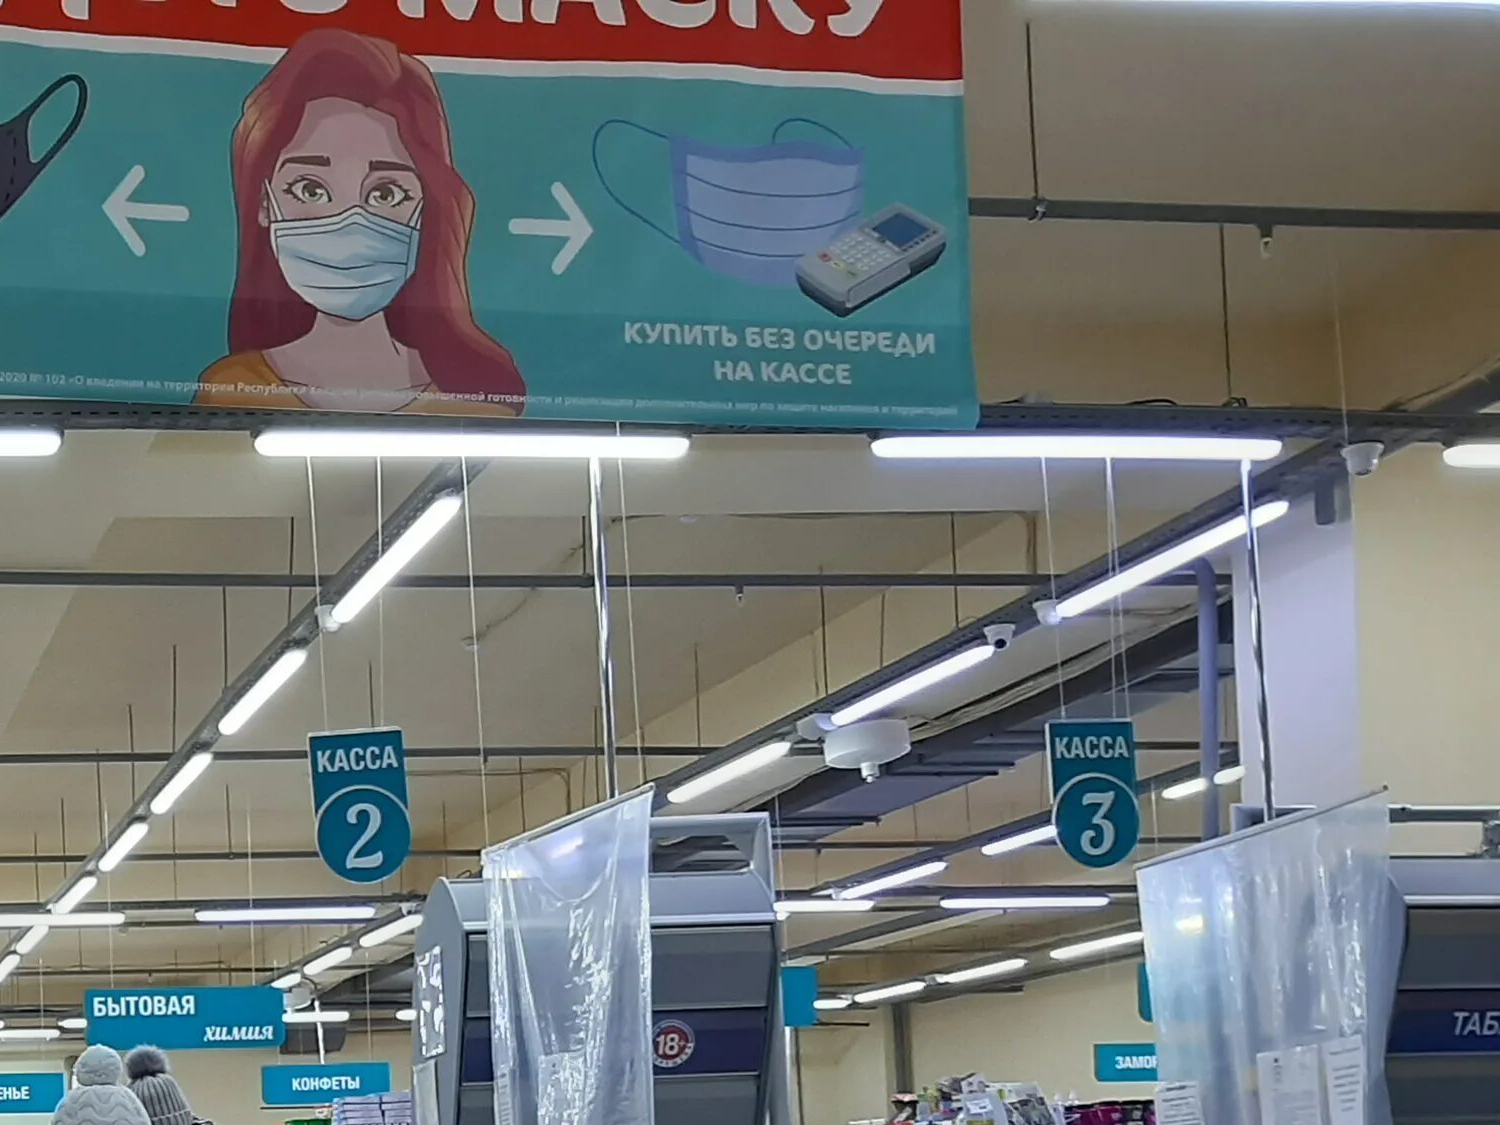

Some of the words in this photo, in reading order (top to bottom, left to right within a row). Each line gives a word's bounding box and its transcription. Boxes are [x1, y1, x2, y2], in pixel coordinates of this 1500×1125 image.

[624, 321, 737, 348] КУПИТЬ
[745, 326, 795, 349] БЕЗ
[803, 328, 936, 358] ОЧЕРЕДИ
[713, 360, 754, 382] НА
[760, 361, 853, 385] КАССЕ
[316, 745, 399, 773] КАССА
[1054, 735, 1130, 759] КАССА
[1080, 790, 1116, 856] 3
[345, 802, 384, 870] 2
[92, 994, 196, 1018] БЫТОВАЯ
[203, 1024, 275, 1043] химия
[1453, 1011, 1500, 1036] ТАБ
[292, 1075, 360, 1091] КОНФЕТЫ
